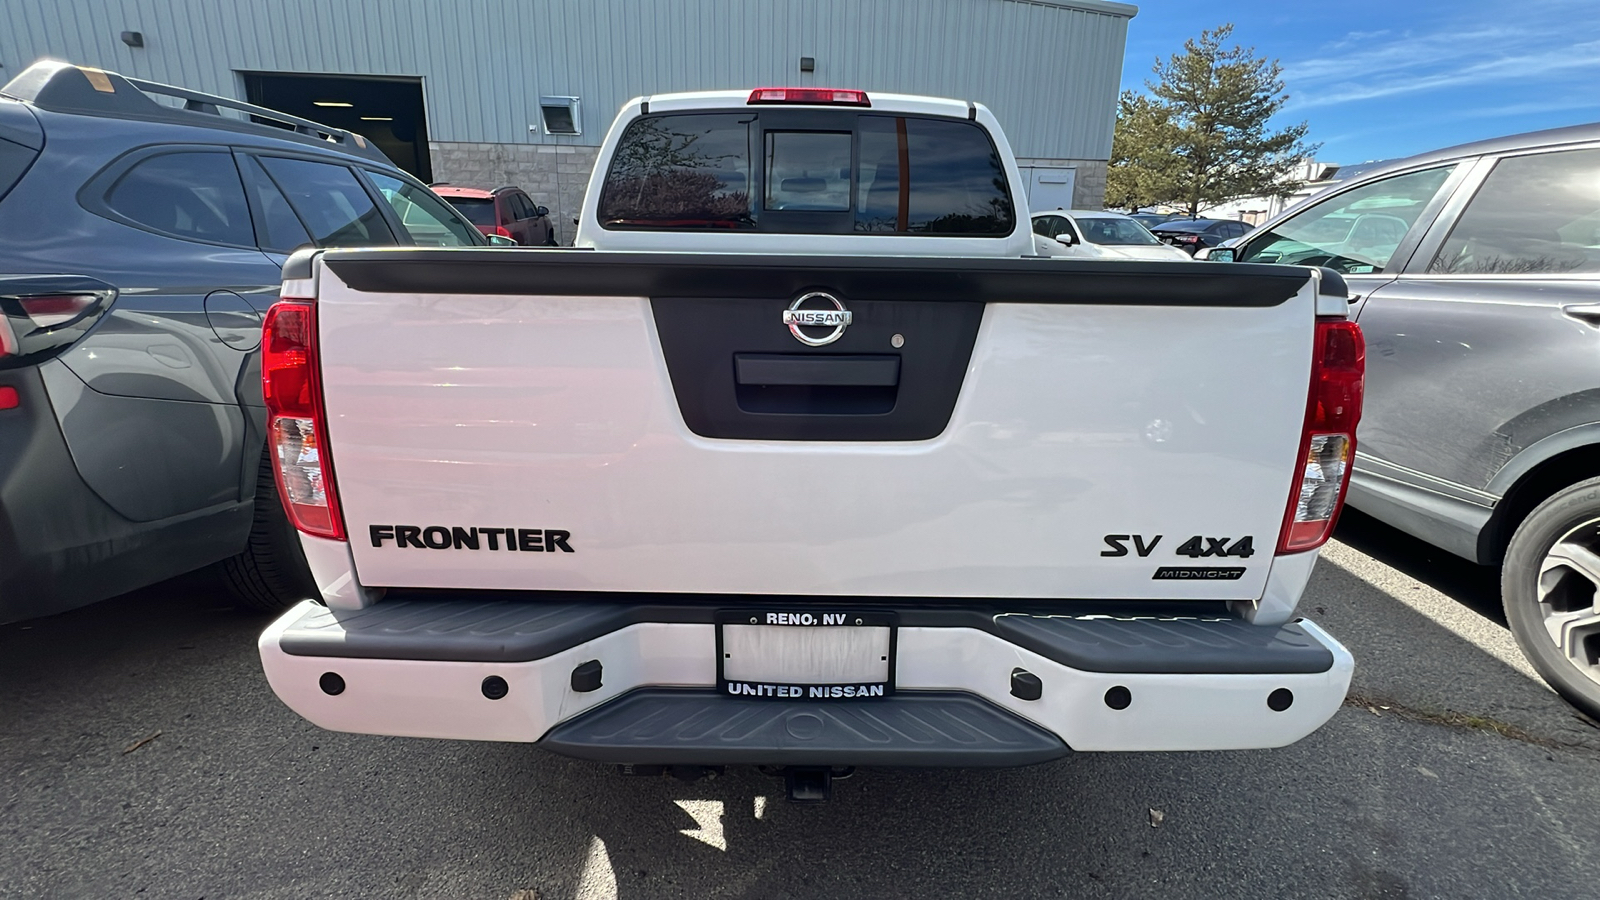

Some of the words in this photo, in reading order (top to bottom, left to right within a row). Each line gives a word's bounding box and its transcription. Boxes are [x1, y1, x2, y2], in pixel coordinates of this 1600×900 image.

[790, 313, 845, 323] NISSAN
[369, 525, 575, 553] FRONTIER
[1100, 534, 1163, 557] SV
[1159, 570, 1242, 578] MIDNIGHT
[766, 612, 818, 626] RENO,
[822, 613, 847, 625] NV
[728, 682, 803, 698] UNITED
[809, 685, 884, 698] NISSAN
